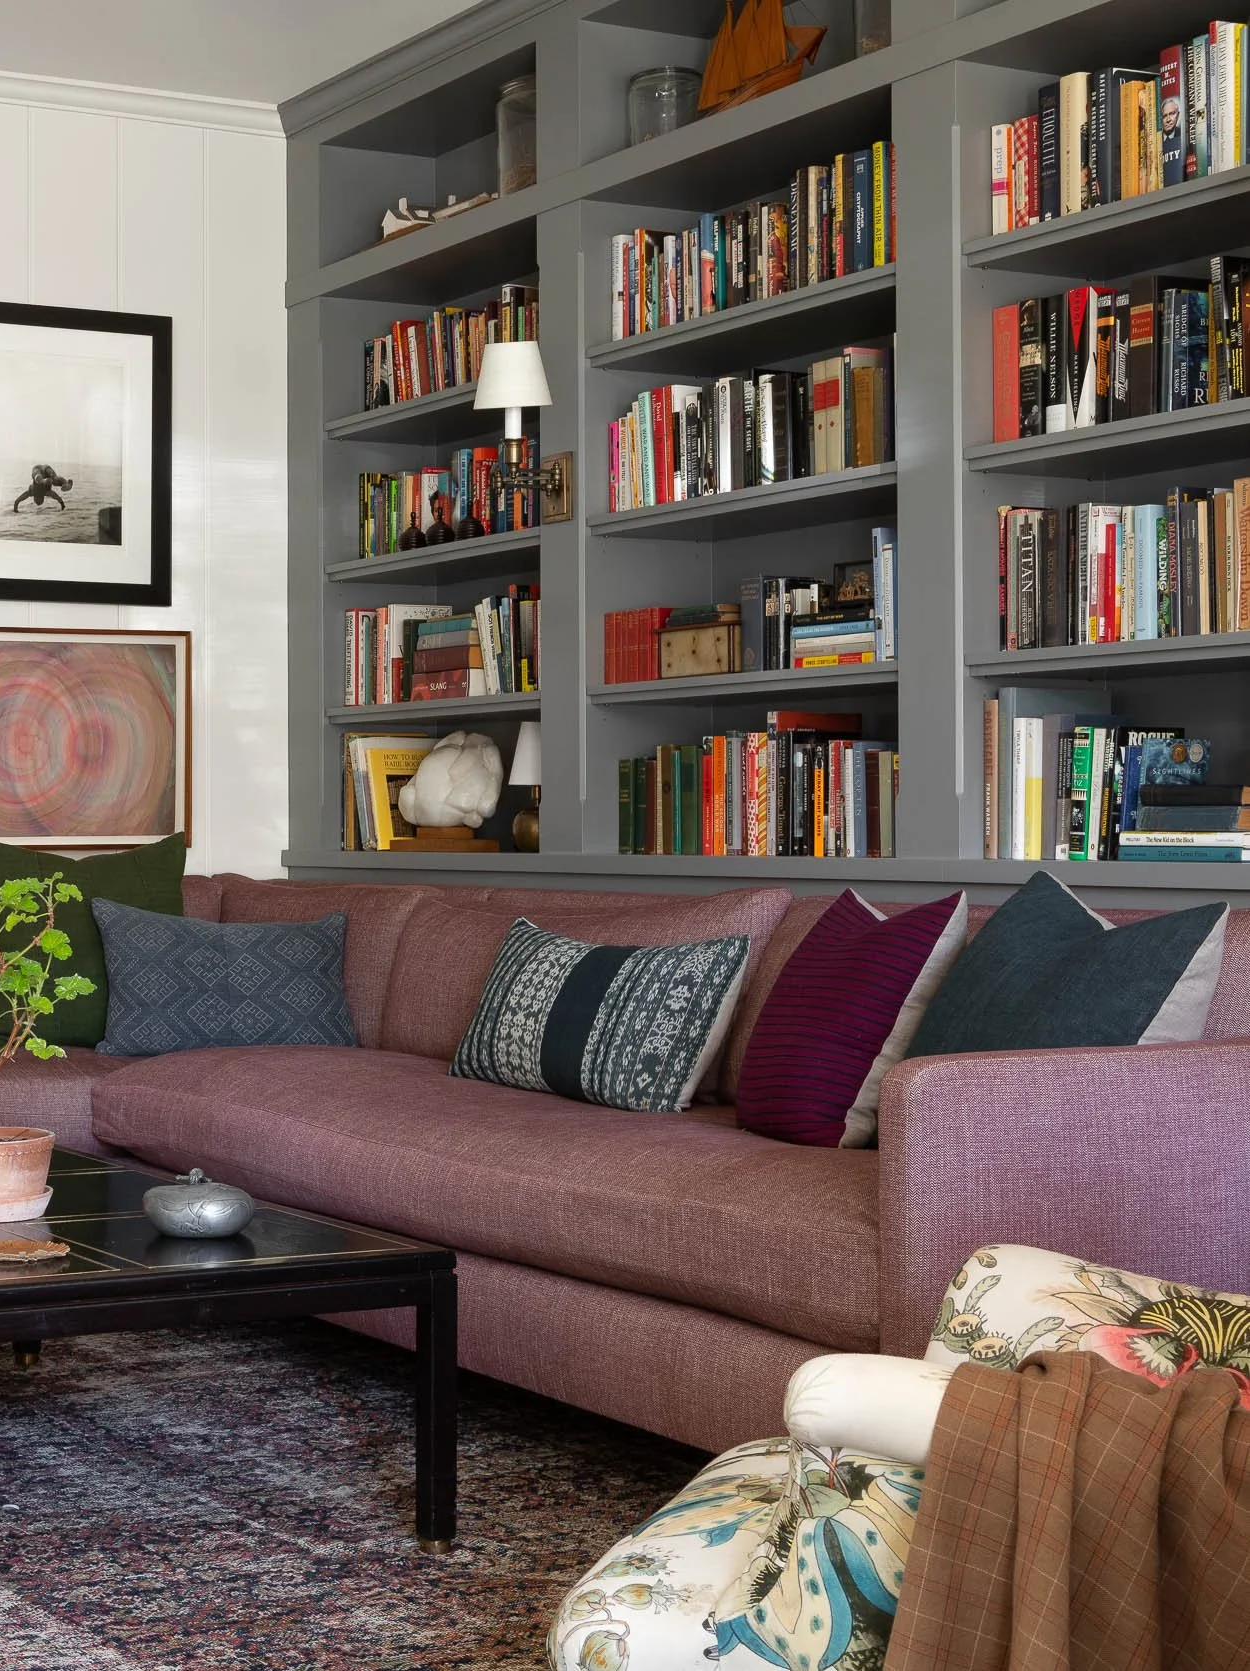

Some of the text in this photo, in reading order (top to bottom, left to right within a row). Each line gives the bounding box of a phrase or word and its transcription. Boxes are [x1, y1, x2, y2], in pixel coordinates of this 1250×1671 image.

[1187, 63, 1195, 105] COMPANY
[1042, 108, 1055, 167] ETIQUETTE
[874, 146, 883, 242] MONEY FROM THIN AIR
[1049, 312, 1057, 350] WILLIE
[1180, 303, 1188, 331] BRIDGE
[744, 380, 754, 415] EARTH:
[1180, 361, 1188, 396] RICHARD
[1021, 530, 1034, 593] TITAN
[1167, 521, 1177, 593] DIANA MOSLEY
[1239, 506, 1250, 576] Watership
[1157, 538, 1168, 591] WILDING
[1239, 581, 1250, 623] Down
[430, 682, 447, 691] SLANG
